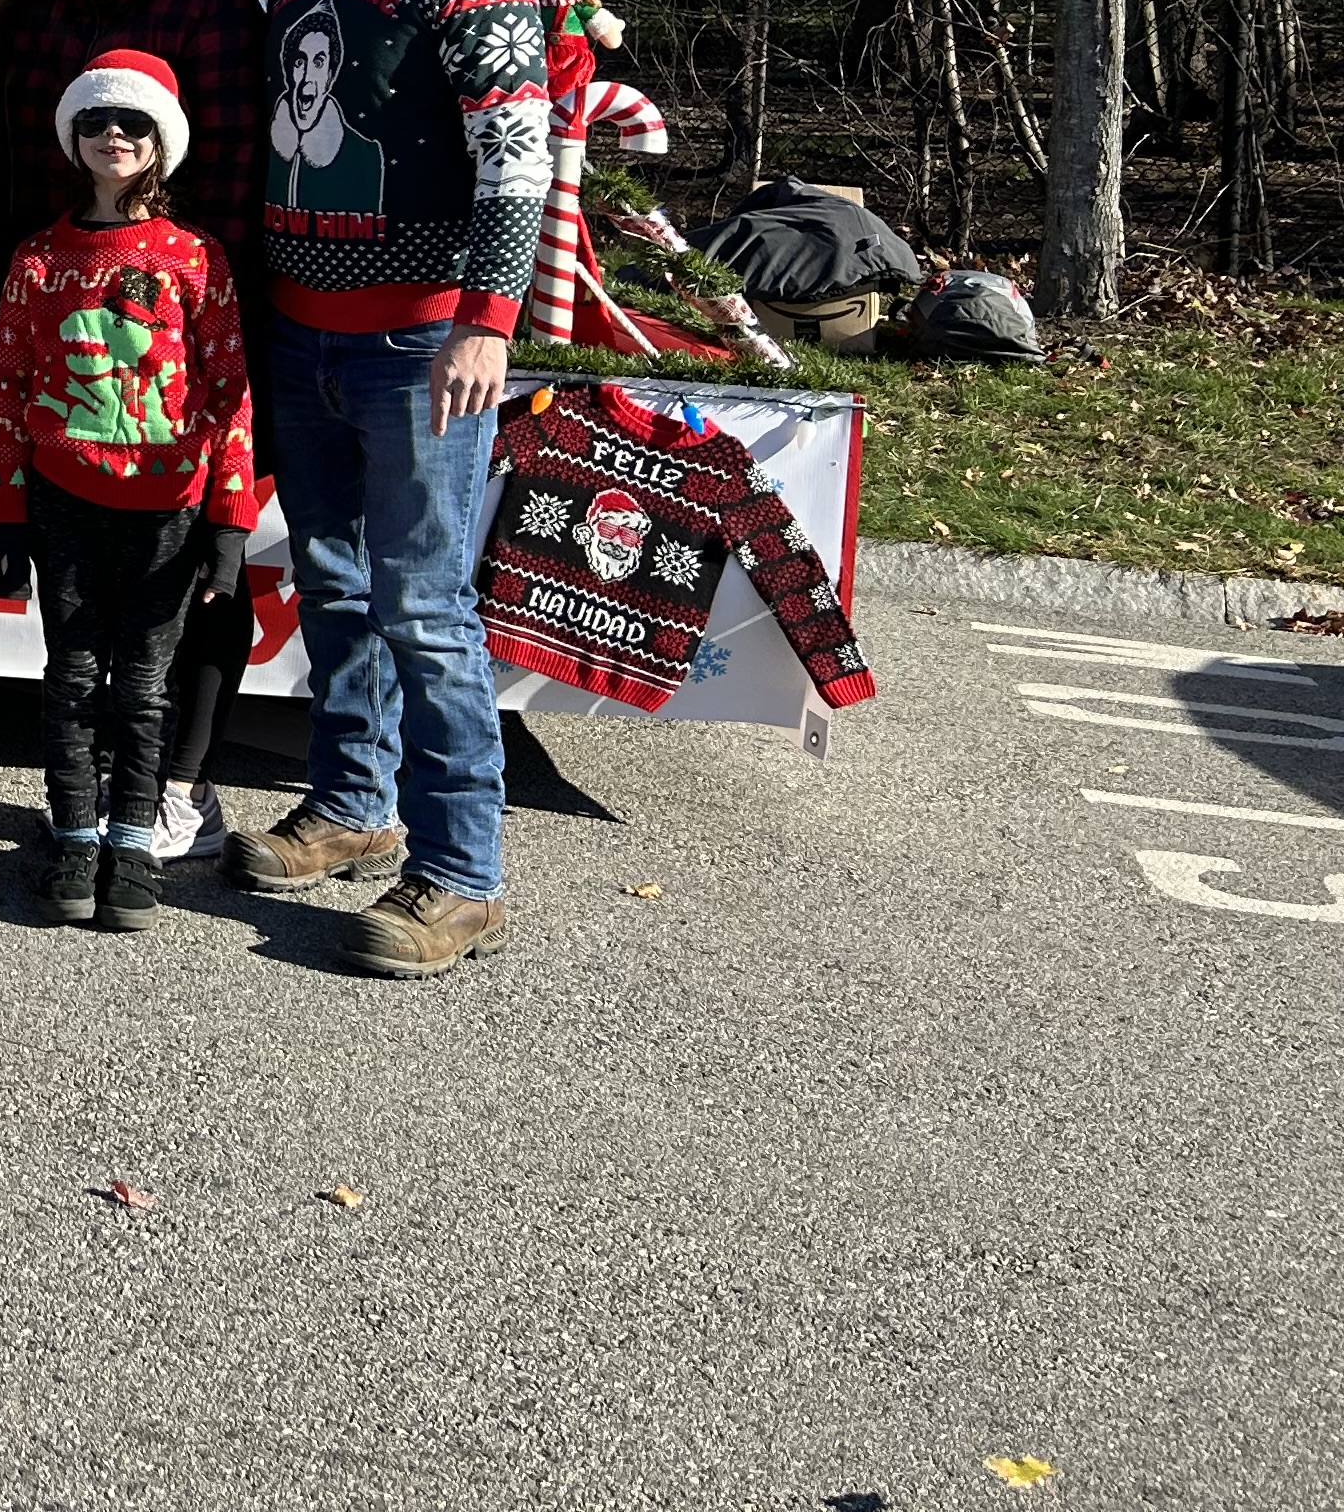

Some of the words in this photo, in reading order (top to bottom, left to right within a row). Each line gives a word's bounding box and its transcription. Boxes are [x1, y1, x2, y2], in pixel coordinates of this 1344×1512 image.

[314, 210, 388, 244] HIM!
[592, 440, 683, 489] FELIZ
[528, 586, 646, 643] NAVIDAD
